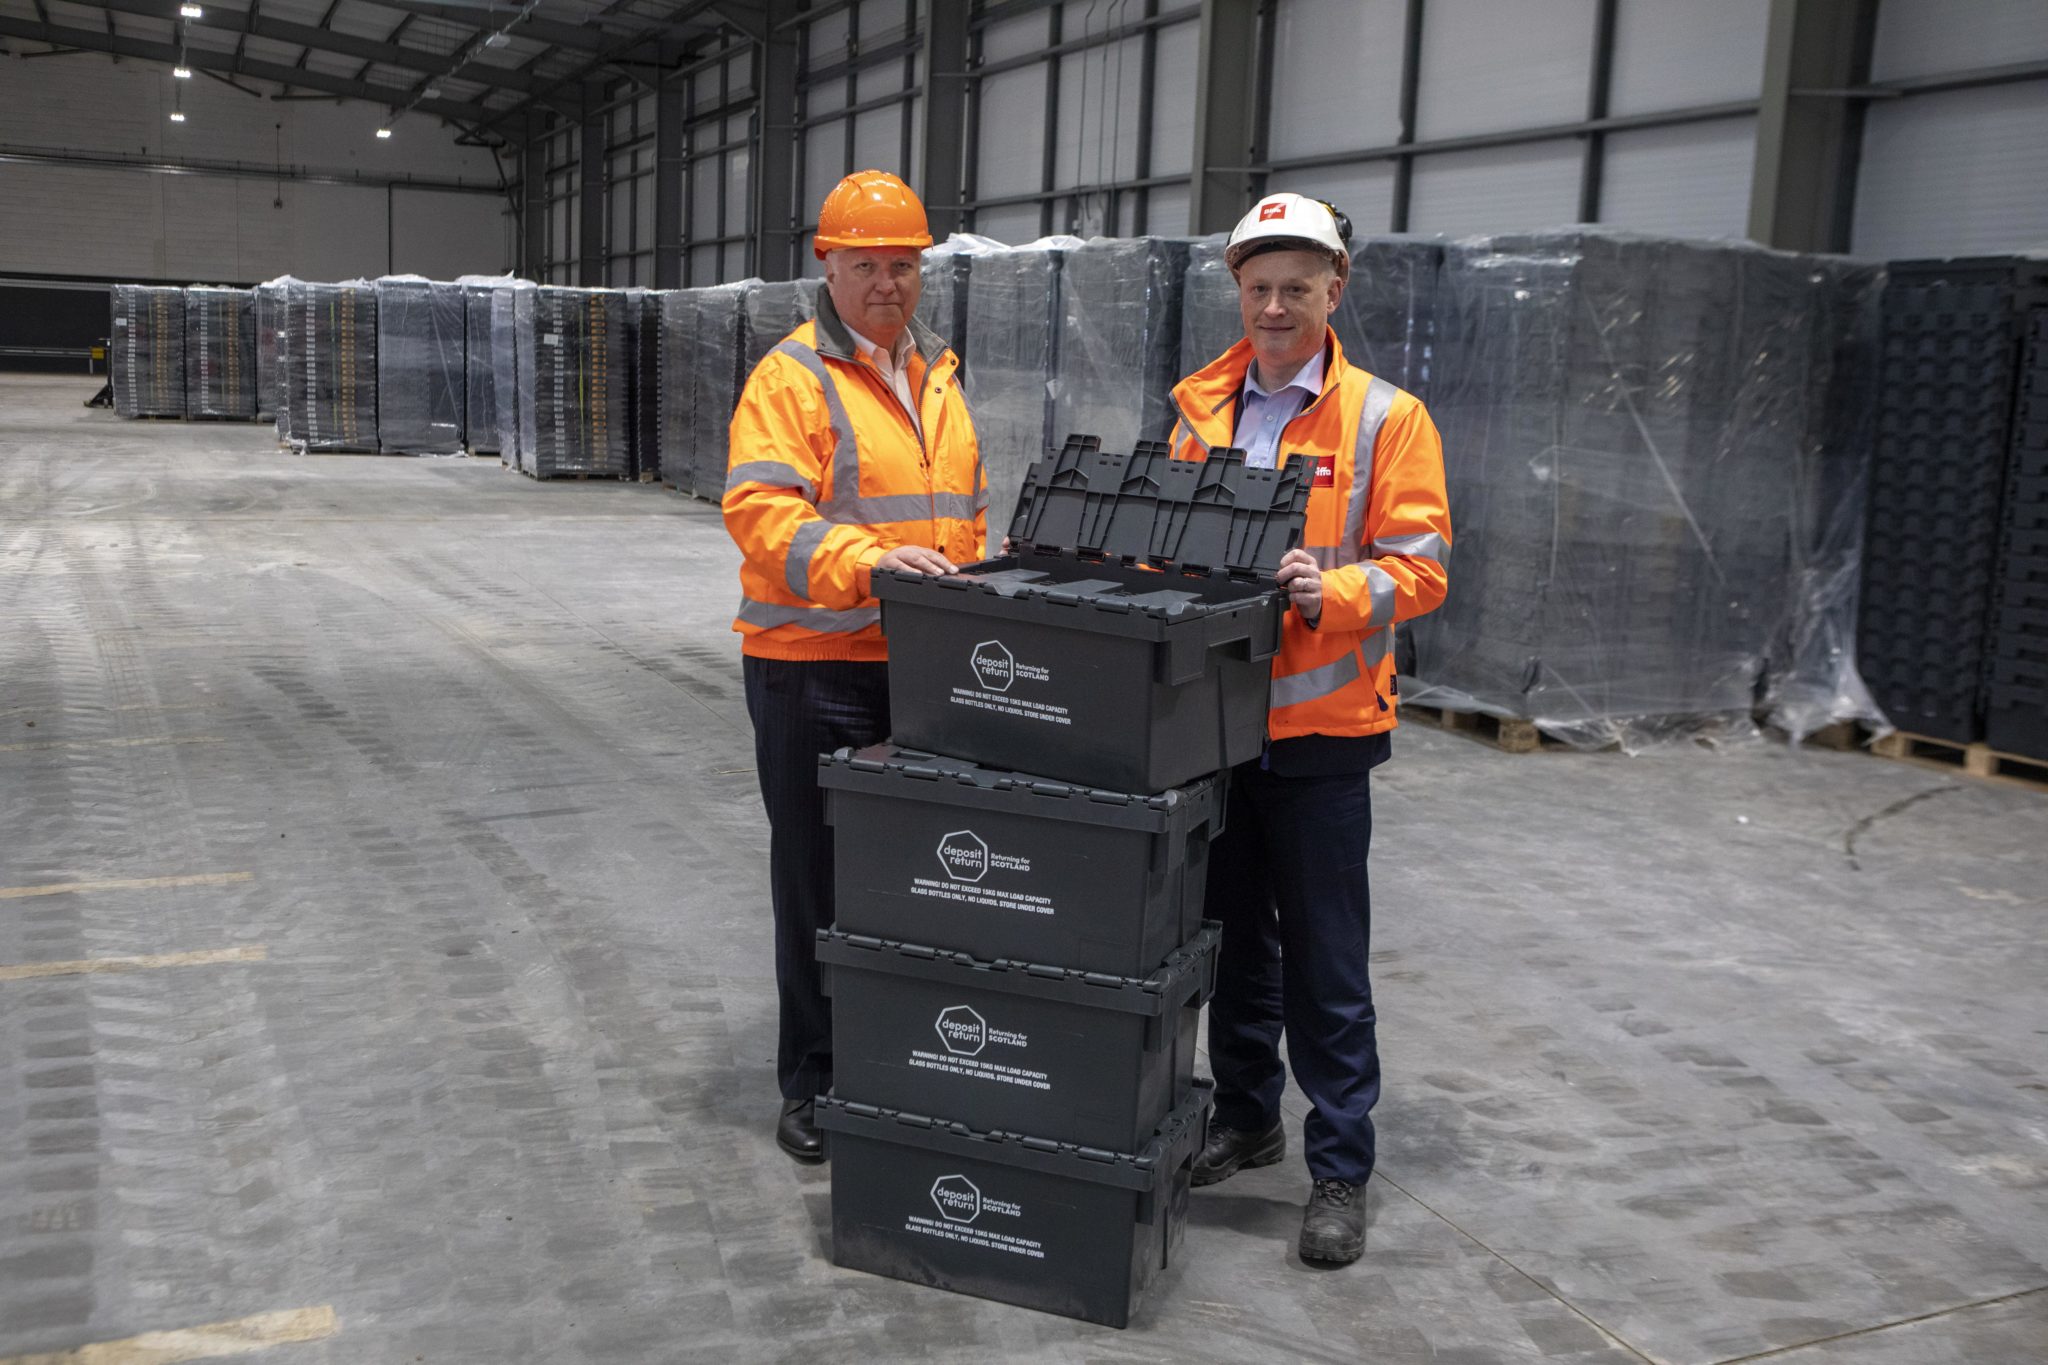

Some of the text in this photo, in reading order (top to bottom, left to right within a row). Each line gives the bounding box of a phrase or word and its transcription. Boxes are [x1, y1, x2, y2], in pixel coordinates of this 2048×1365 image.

[1315, 466, 1331, 476] iffa
[977, 655, 1008, 669] deposit
[1016, 663, 1040, 674] Returning
[982, 666, 1008, 678] return
[1016, 670, 1049, 681] SCOTLAND
[953, 687, 1068, 715] WARNING! DO NOT EXCEED 15KG MAX LOAD CAPACITY
[951, 696, 964, 705] GLASS
[965, 699, 983, 709] BOTTLES
[985, 703, 997, 712] ONLY,
[1024, 710, 1038, 719] STORE
[1040, 713, 1055, 722] UNDER
[1056, 716, 1071, 725] COVER
[944, 845, 982, 859] deposit
[991, 853, 1019, 864] Returning
[950, 856, 981, 868] return
[991, 861, 1029, 871] SCOTLAND
[914, 878, 1051, 905] WARNING! DO NOT EXCEED 15KG MAX LOAD CAPACITY
[911, 887, 927, 896] GLASS
[929, 889, 950, 899] BOTTLES
[952, 893, 966, 902] ONLY,
[968, 895, 975, 903] NO
[1000, 900, 1016, 909] STORE
[1018, 903, 1035, 912] UNDER
[1037, 905, 1054, 915] COVER
[942, 1019, 980, 1033] deposit
[948, 1030, 979, 1043] return
[989, 1028, 1017, 1040] Returning
[989, 1036, 1027, 1047] SCOTLAND
[912, 1050, 1047, 1081] WARNING! DO NOT EXCEED 15KG MAX LOAD CAPACITY
[909, 1058, 925, 1068] GLASS
[927, 1061, 948, 1072] BOTTLES
[950, 1066, 964, 1075] ONLY,
[966, 1068, 973, 1076] NO
[997, 1074, 1013, 1084] STORE
[1015, 1077, 1031, 1087] UNDER
[1033, 1080, 1050, 1090] COVER
[937, 1187, 974, 1202] deposit
[943, 1199, 974, 1210] return
[983, 1197, 1011, 1209] Returning
[983, 1204, 1020, 1216] SCOTLAND
[909, 1215, 1041, 1249] WARNING! DO NOT EXCEED 15KG MAX LOAD CAPACITY
[906, 1224, 921, 1233] GLASS
[923, 1227, 944, 1238] BOTTLES
[945, 1232, 959, 1242] ONLY,
[961, 1235, 968, 1243] NO
[991, 1241, 1007, 1251] STORE
[1009, 1244, 1026, 1255] UNDER
[1027, 1248, 1044, 1258] COVER
